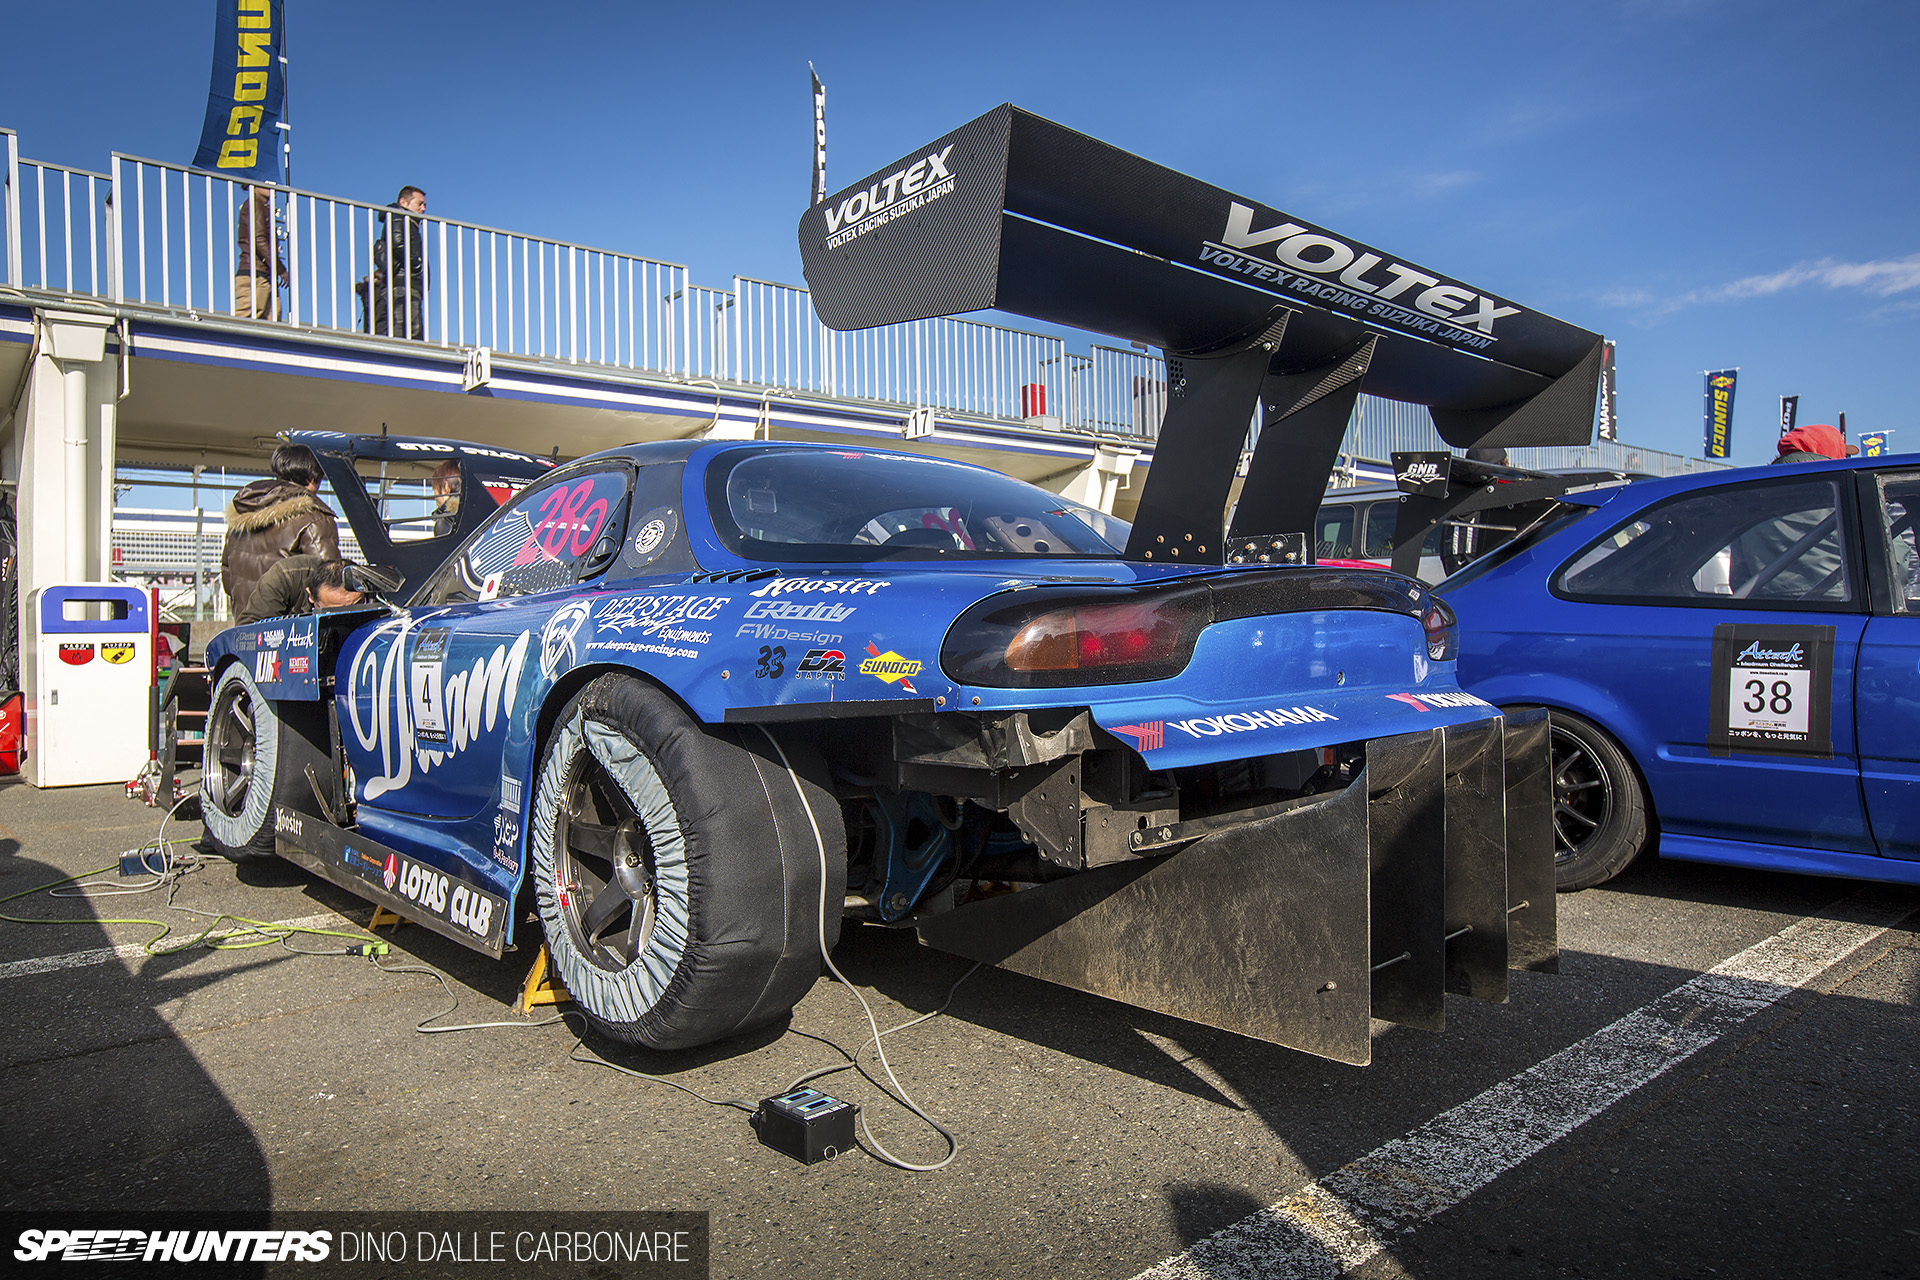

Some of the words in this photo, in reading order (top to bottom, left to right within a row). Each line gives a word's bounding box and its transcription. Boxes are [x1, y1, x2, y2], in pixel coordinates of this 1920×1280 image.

[825, 144, 954, 234] VOLTEX
[827, 227, 857, 250] VOLTEX
[858, 213, 889, 236] RACING
[889, 196, 925, 221] SUZUKA
[925, 179, 954, 204] JAPAN
[1221, 201, 1521, 334] VOLTEX
[1198, 246, 1293, 286] VOLTEX
[1288, 277, 1369, 311] RACING
[1367, 303, 1440, 335] SUZUKA
[1437, 329, 1493, 350] JAPAN
[470, 351, 482, 385] 16
[913, 410, 928, 435] 17
[1712, 389, 1728, 457] SUNOCO
[1407, 463, 1438, 475] GNR
[511, 479, 608, 568] 280
[748, 577, 891, 598] Hoosier
[593, 595, 731, 620] DEEPSTAGE
[743, 600, 857, 622] GReddy
[596, 614, 685, 636] Racing
[657, 626, 712, 644] Equipments
[584, 640, 698, 659] www.deepstage-racing.com
[797, 649, 845, 672] D2
[795, 671, 845, 681] JAPAN
[862, 660, 919, 674] SUNOCO
[422, 674, 431, 712] 4
[1743, 679, 1793, 714] 38
[1166, 705, 1339, 738] YOKOHAMA
[399, 860, 449, 914] LOTAS
[450, 884, 493, 937] CLUB
